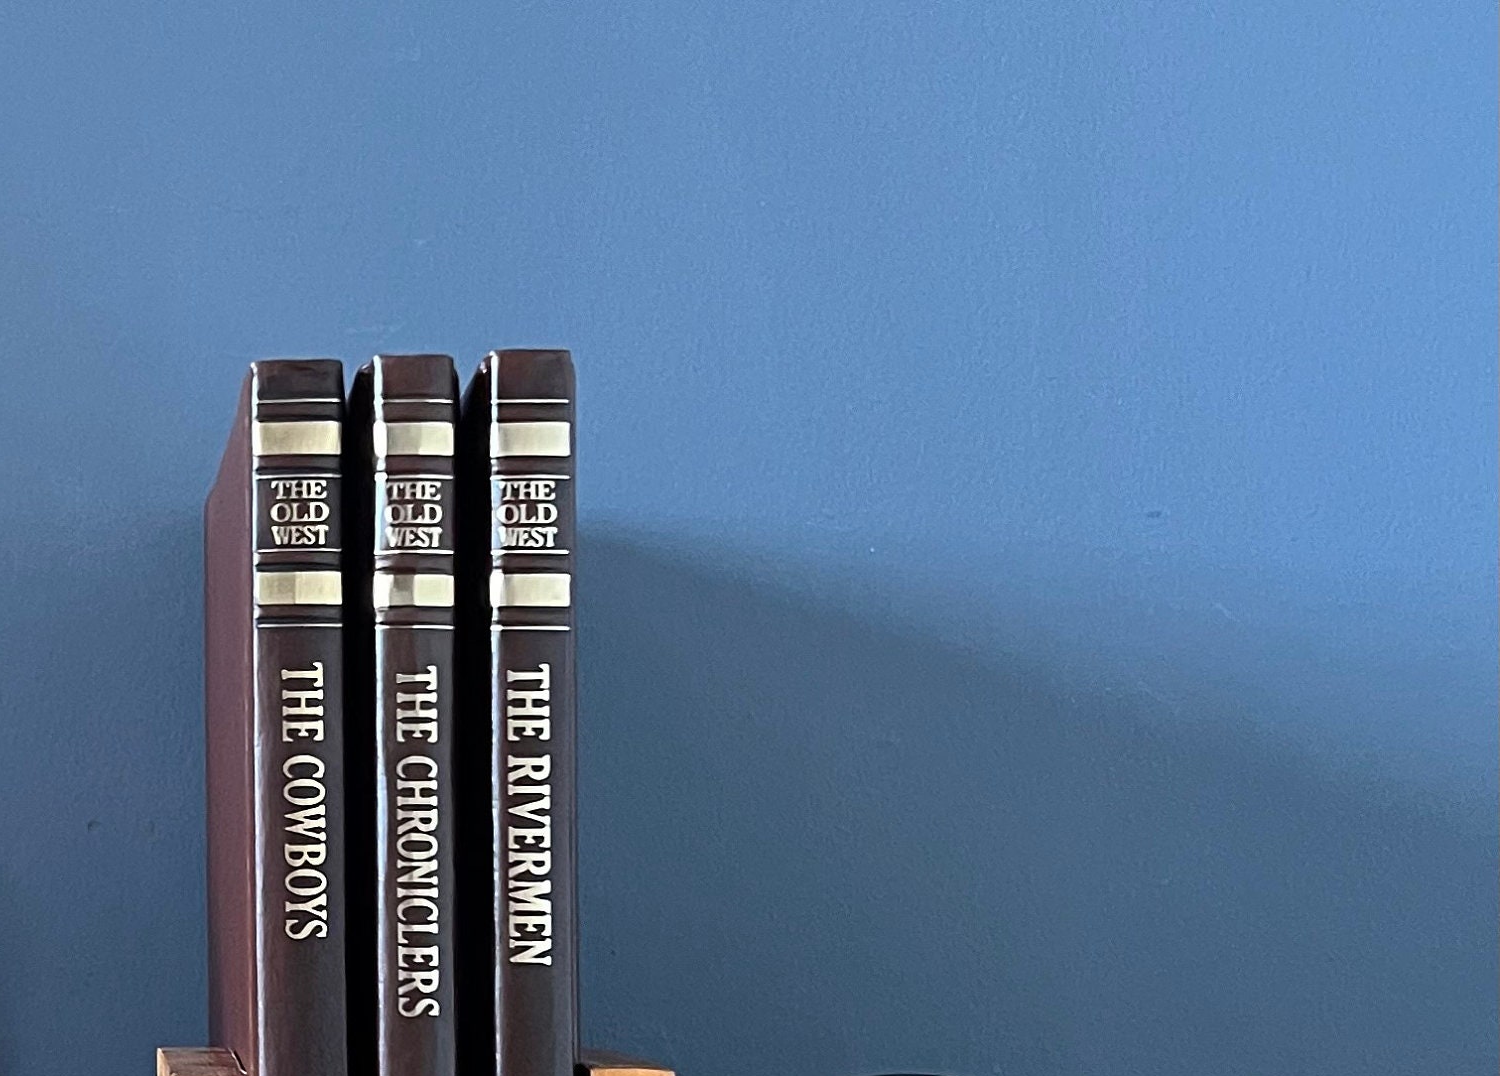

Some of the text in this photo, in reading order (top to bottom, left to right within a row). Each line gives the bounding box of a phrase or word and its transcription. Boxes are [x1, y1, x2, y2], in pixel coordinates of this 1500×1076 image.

[270, 480, 328, 499] THE
[386, 481, 442, 500] THE
[500, 480, 556, 500] THE
[269, 501, 330, 524] OLD
[384, 502, 443, 525] OLD
[497, 502, 557, 525] OLD
[271, 525, 329, 546] WEST
[384, 526, 443, 548] WEST
[498, 526, 557, 548] WEST
[281, 662, 328, 940] THE COWBOYS
[506, 663, 553, 966] THE RIVERMEN
[395, 665, 441, 1018] THE CHRONICLERS
